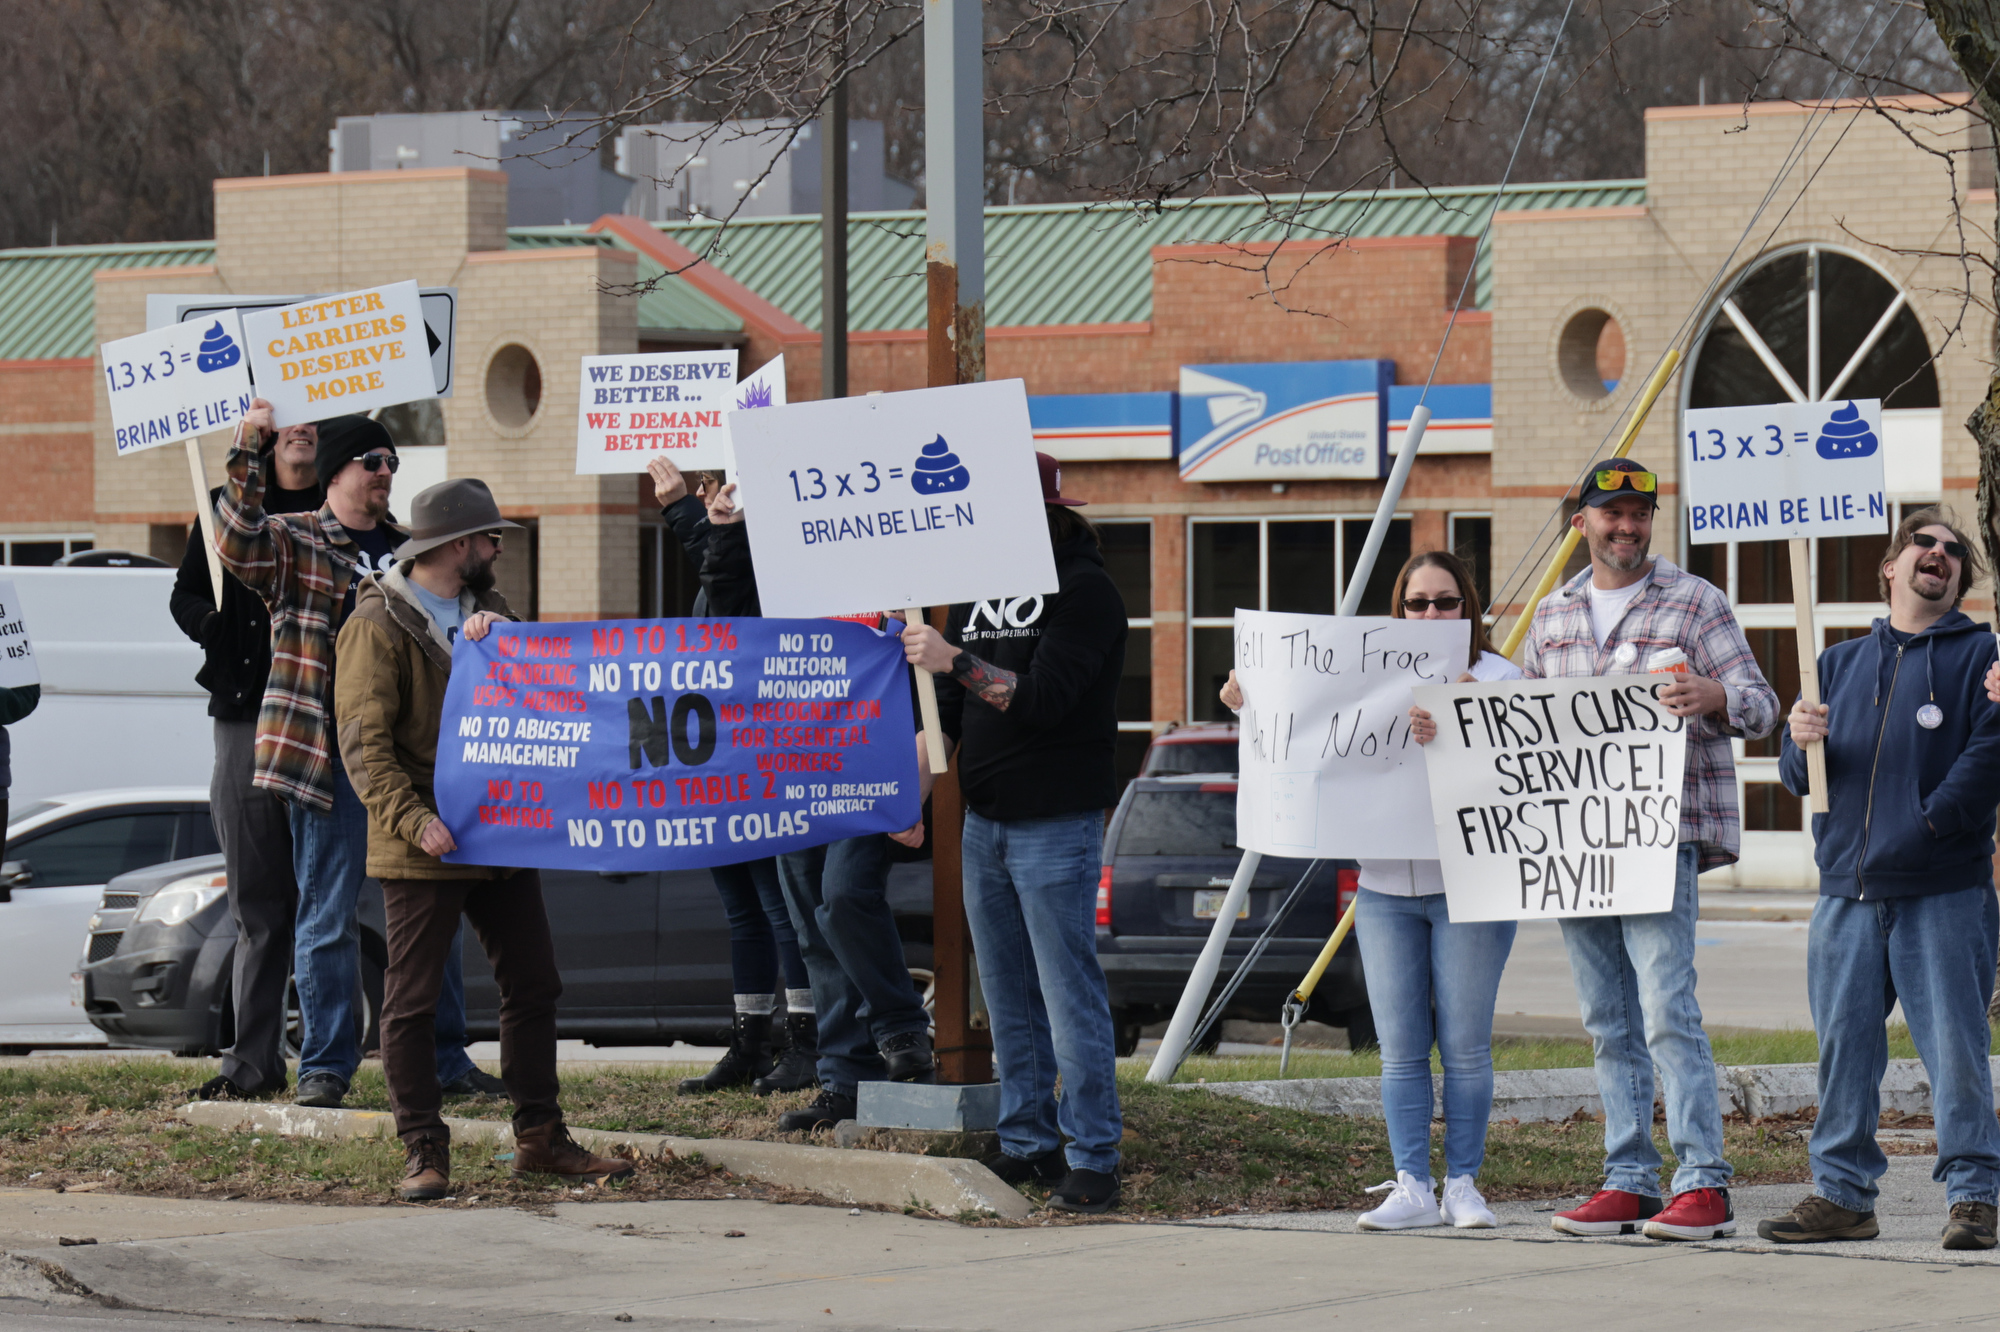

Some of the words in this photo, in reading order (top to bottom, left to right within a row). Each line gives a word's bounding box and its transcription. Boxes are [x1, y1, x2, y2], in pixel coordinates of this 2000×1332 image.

[280, 292, 385, 329] LETTER
[267, 314, 407, 358] CARRIERS
[106, 361, 135, 392] 1.3
[142, 362, 156, 384] x
[159, 351, 175, 377] 3
[280, 341, 406, 381] DESERVE
[588, 365, 623, 383] WE
[629, 362, 731, 382] DESERVE
[305, 371, 385, 403] MORE
[116, 415, 171, 450] BRIAN
[177, 408, 200, 434] BE
[205, 393, 250, 426] LIE-N
[586, 412, 621, 429] WE
[604, 432, 698, 451] BETTER!
[1687, 428, 1726, 462] 1.3
[1736, 436, 1756, 459] x
[1764, 424, 1784, 456] 3
[788, 467, 827, 502] 1.3
[835, 473, 855, 497] x
[860, 461, 881, 493] 3
[801, 514, 875, 545] BRIAN
[877, 510, 908, 536] BE
[910, 502, 975, 533] LIE-N
[1692, 500, 1768, 531] BRIAN
[1779, 498, 1810, 525] BE
[1820, 491, 1884, 522] LIE-N
[0, 619, 24, 636] ent
[962, 594, 1044, 633] NO
[6, 640, 30, 660] us!
[498, 636, 520, 657] NO
[524, 636, 572, 658] MORE
[591, 627, 624, 657] NO
[633, 625, 666, 655] TO
[675, 622, 738, 653] 1.3%
[779, 633, 804, 652] NO
[810, 633, 833, 652] TO
[1281, 629, 1340, 675] The
[485, 661, 577, 685] IGNORING
[588, 662, 621, 692] NO
[629, 661, 662, 691] TO
[671, 660, 734, 690] CCAS
[764, 656, 847, 676] UNIFORM
[473, 685, 518, 707] USPS
[522, 691, 587, 713] HEROES
[757, 679, 851, 699] MONOPOLY
[720, 703, 745, 723] NO
[752, 699, 881, 722] RECOGNITION
[1453, 693, 1560, 748] FIRST
[1571, 683, 1684, 737] CLASS
[458, 716, 482, 737] NO
[488, 716, 510, 738] TO
[514, 717, 592, 742] ABUSIVE
[627, 693, 717, 769] NO
[732, 727, 766, 748] FOR
[773, 725, 870, 747] ESSENTIAL
[462, 742, 580, 768] MANAGEMENT
[756, 752, 843, 772] WORKERS
[1494, 742, 1664, 796] SERVICE!
[488, 779, 513, 800] NO
[519, 781, 543, 802] TO
[588, 781, 623, 809] NO
[632, 779, 666, 808] TO
[675, 773, 751, 806] TABLE
[760, 771, 777, 799] 2
[785, 785, 805, 799] NO
[809, 784, 827, 798] TO
[831, 781, 899, 797] BREAKING
[478, 805, 554, 828] RENFROE
[810, 799, 875, 816] CONRTACT
[567, 819, 603, 848] NO
[611, 819, 646, 848] TO
[655, 817, 717, 847] DIET
[728, 810, 810, 842] COLAS
[1457, 798, 1570, 856] FIRST
[1580, 795, 1678, 849] CLASS
[1519, 852, 1615, 911] PAY!!!
